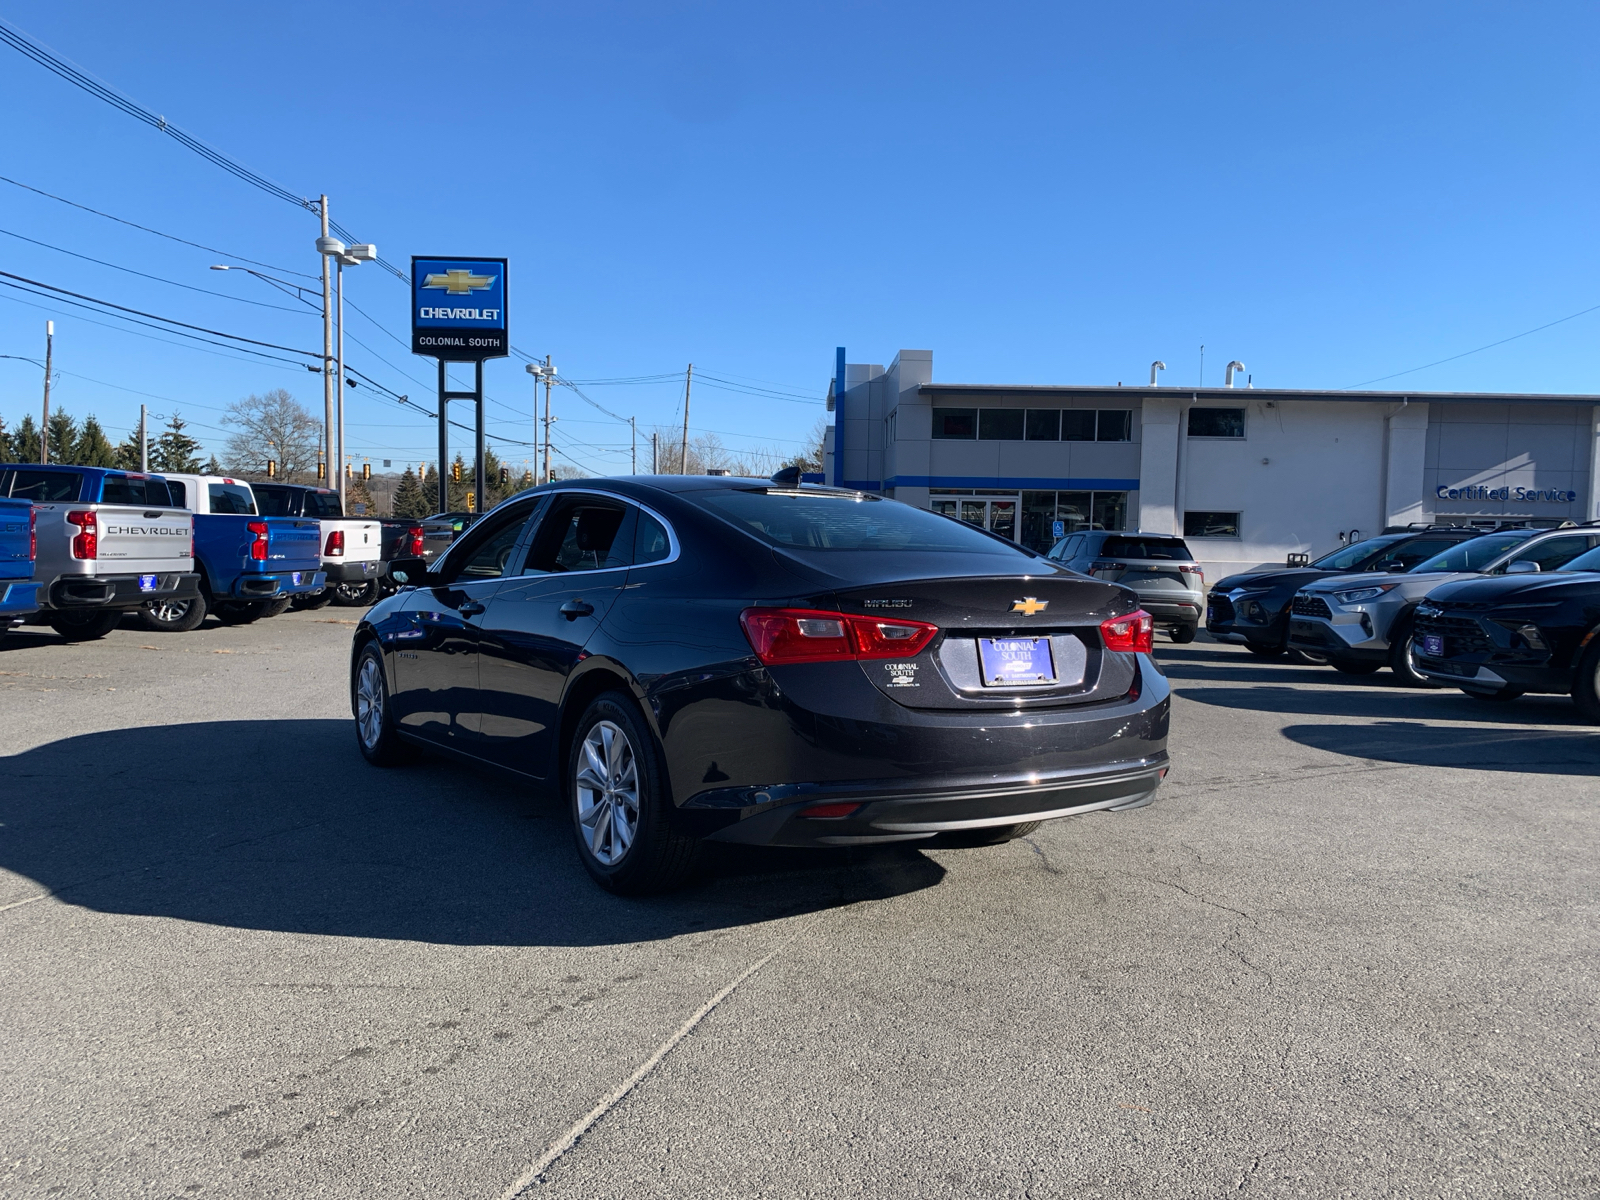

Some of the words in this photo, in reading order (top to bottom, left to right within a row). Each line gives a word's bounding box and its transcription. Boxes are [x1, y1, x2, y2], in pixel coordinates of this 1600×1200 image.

[420, 307, 500, 320] CHEVROLET
[419, 336, 466, 346] COLONIAL
[468, 337, 500, 347] SOUTH
[1436, 485, 1509, 501] Certified
[1515, 487, 1577, 502] Service
[0, 524, 27, 533] ET
[107, 526, 189, 536] CHEVROLET
[863, 599, 913, 608] MALIBU
[993, 641, 1037, 652] COLONIAL
[1001, 651, 1032, 661] SOUTH
[884, 663, 919, 671] COLONIAL
[890, 669, 914, 677] SOUTH
